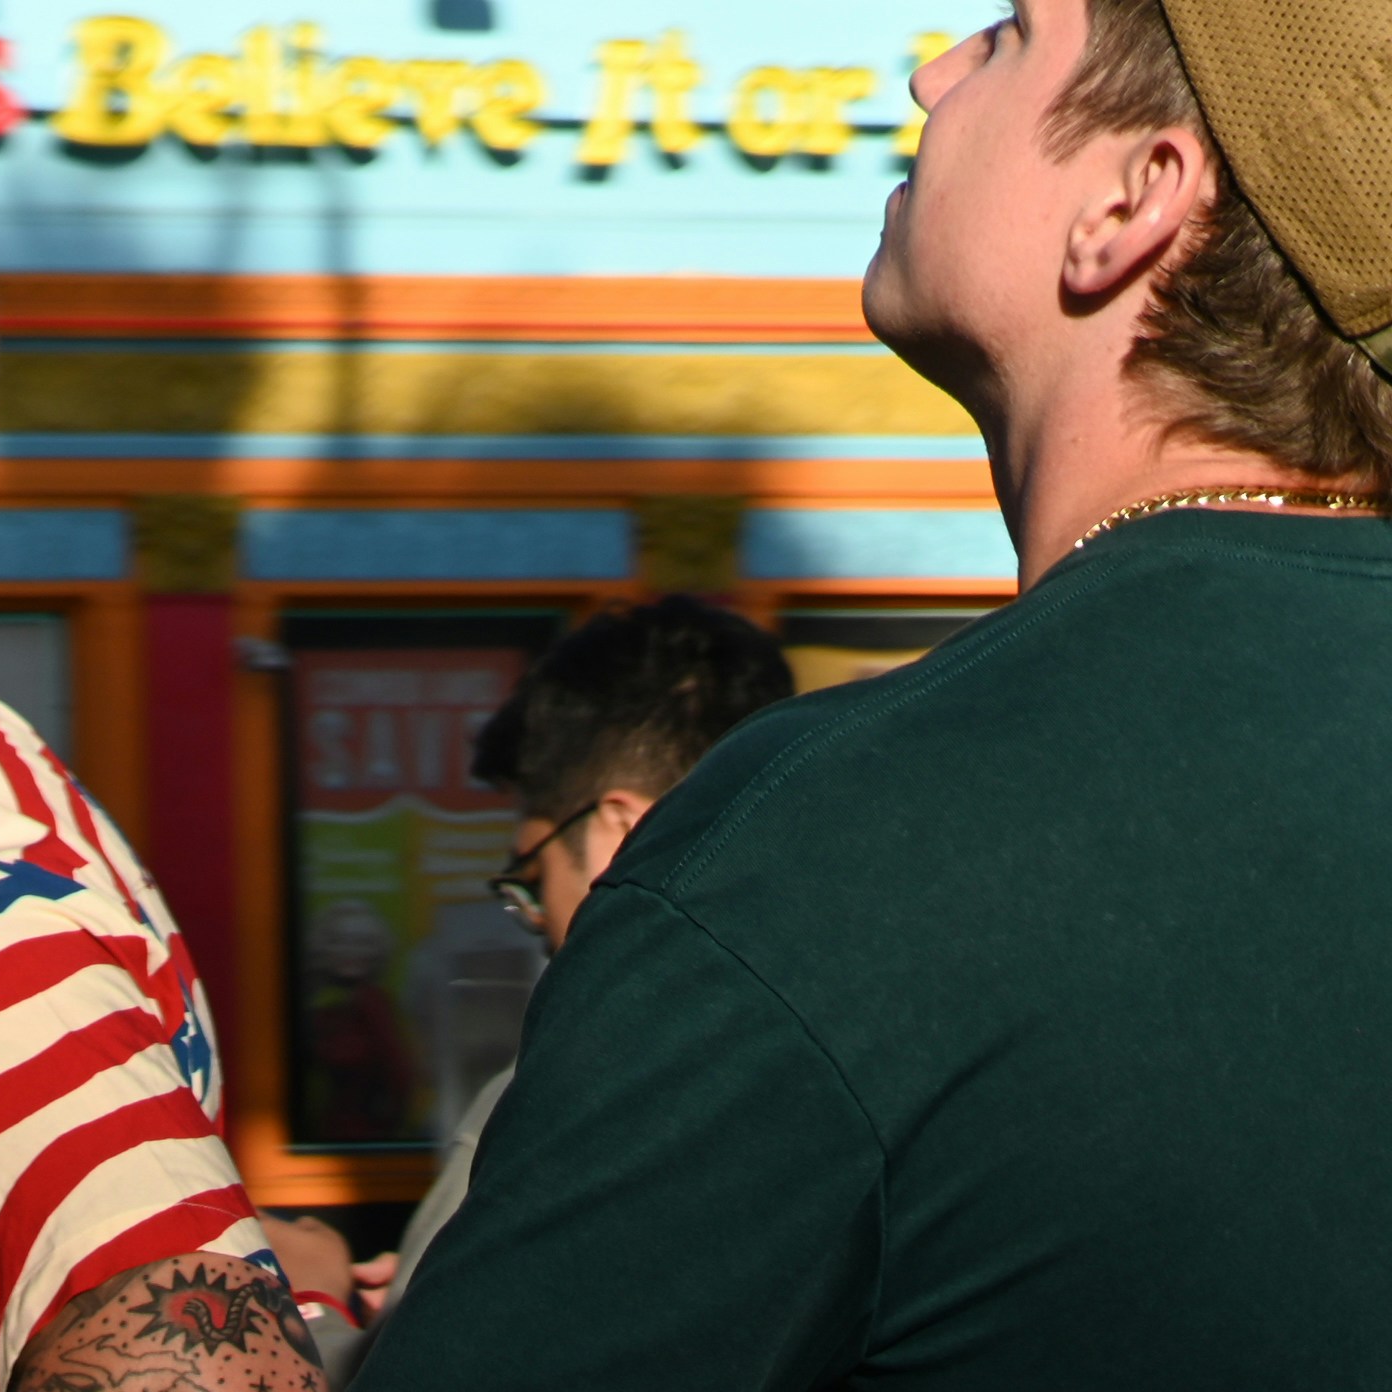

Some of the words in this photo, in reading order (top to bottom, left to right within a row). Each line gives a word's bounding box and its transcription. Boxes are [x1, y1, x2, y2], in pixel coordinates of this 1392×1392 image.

[52, 14, 546, 148] Believe
[578, 32, 704, 165] It
[726, 66, 876, 156] or
